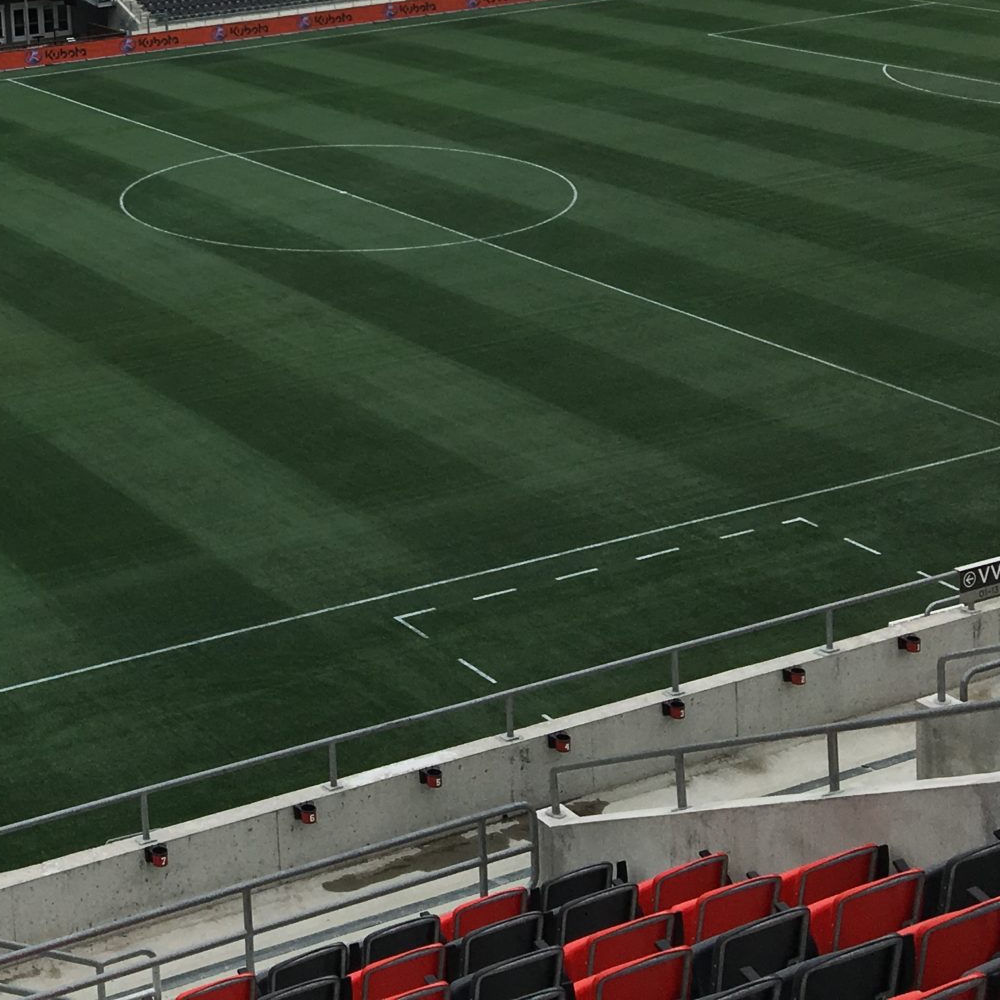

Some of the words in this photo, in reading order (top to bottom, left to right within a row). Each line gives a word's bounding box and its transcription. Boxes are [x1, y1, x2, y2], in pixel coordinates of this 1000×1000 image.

[399, 2, 437, 14] Kubota
[314, 13, 352, 25] Kubota
[230, 24, 269, 37] Kubota
[138, 35, 179, 48] Kubota
[45, 46, 88, 60] Kubota
[564, 743, 570, 751] 4
[435, 778, 442, 786] 5
[309, 813, 316, 822] 6
[160, 856, 167, 866] 7
